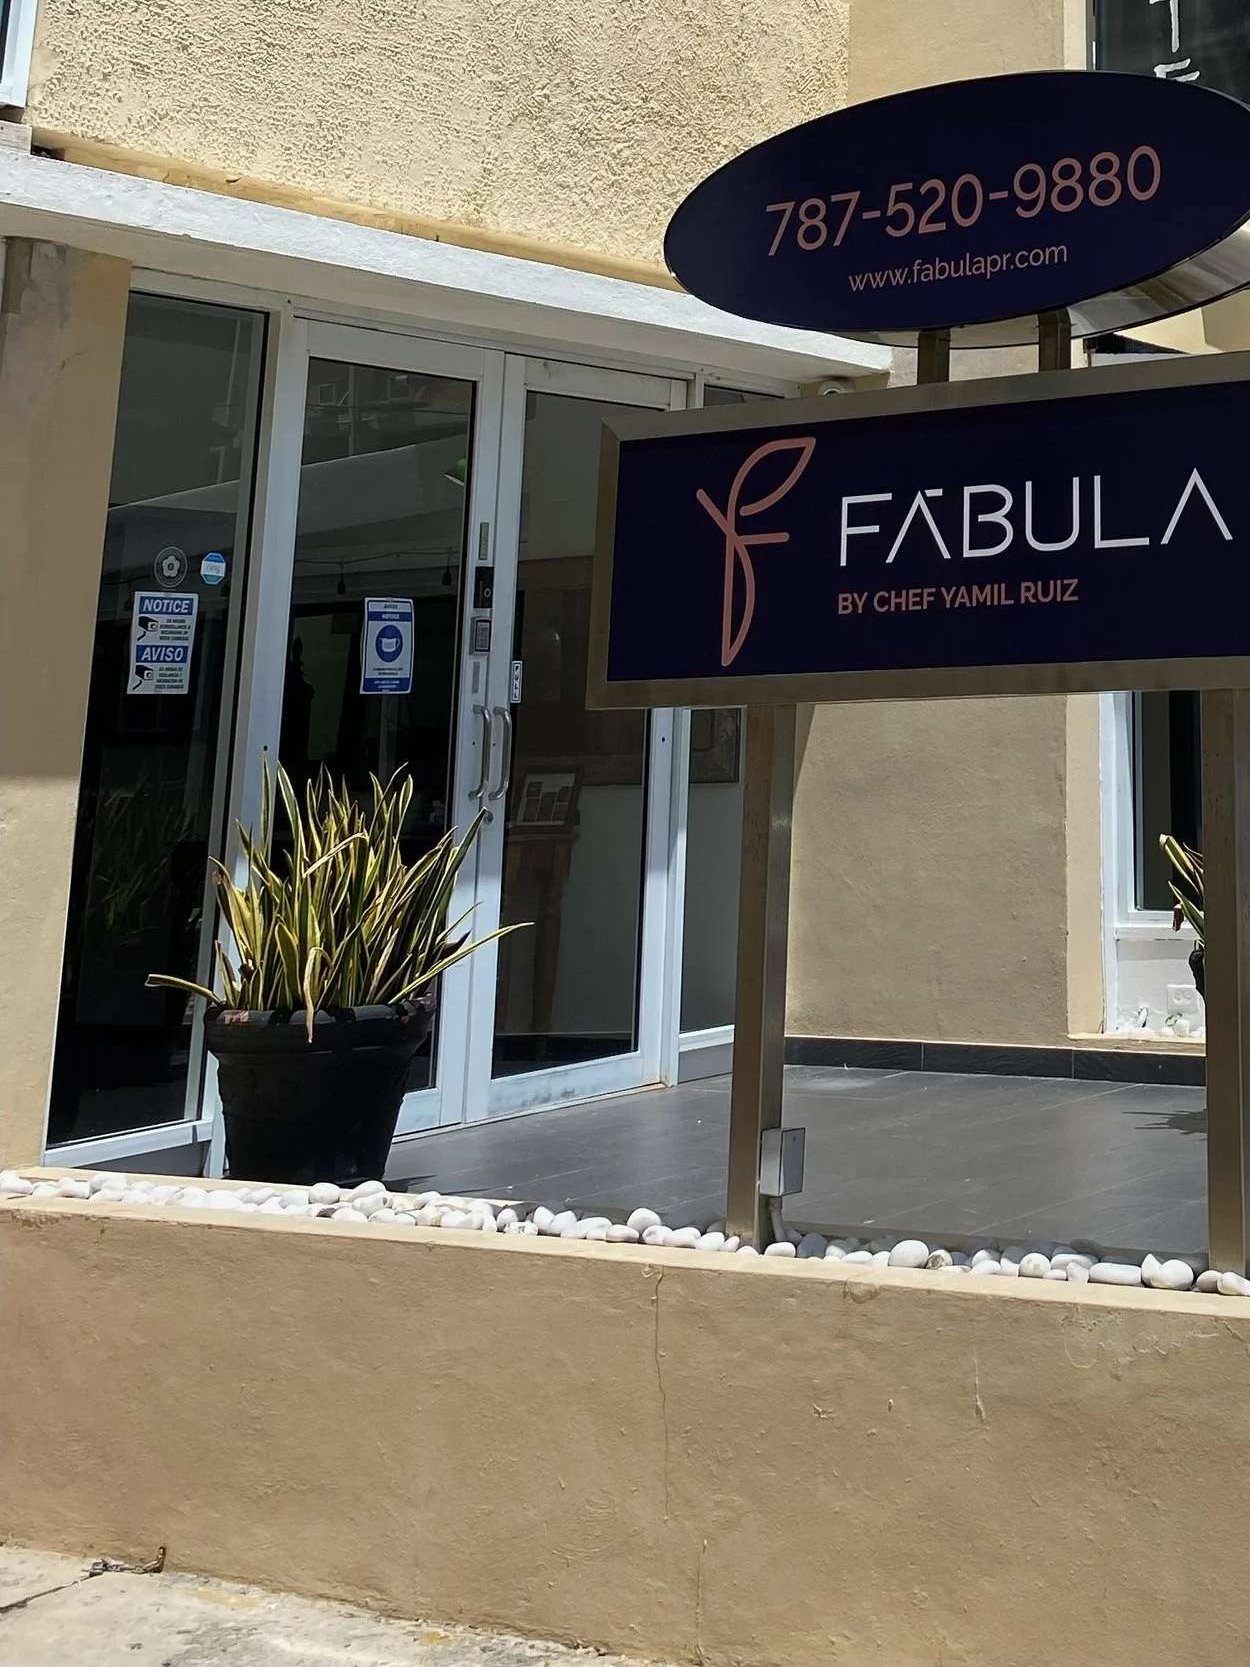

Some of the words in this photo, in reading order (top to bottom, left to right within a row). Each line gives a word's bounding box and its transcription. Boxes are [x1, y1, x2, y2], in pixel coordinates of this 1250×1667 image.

[764, 144, 1161, 257] 787-520-9880
[848, 245, 1067, 292] www.fabulapr.com
[142, 598, 190, 613] NOTICE
[838, 592, 868, 615] BY
[873, 587, 936, 613] CHEF
[940, 583, 1015, 608] YAMIL
[1020, 578, 1079, 604] RUIZ
[141, 646, 184, 661] AVISO
